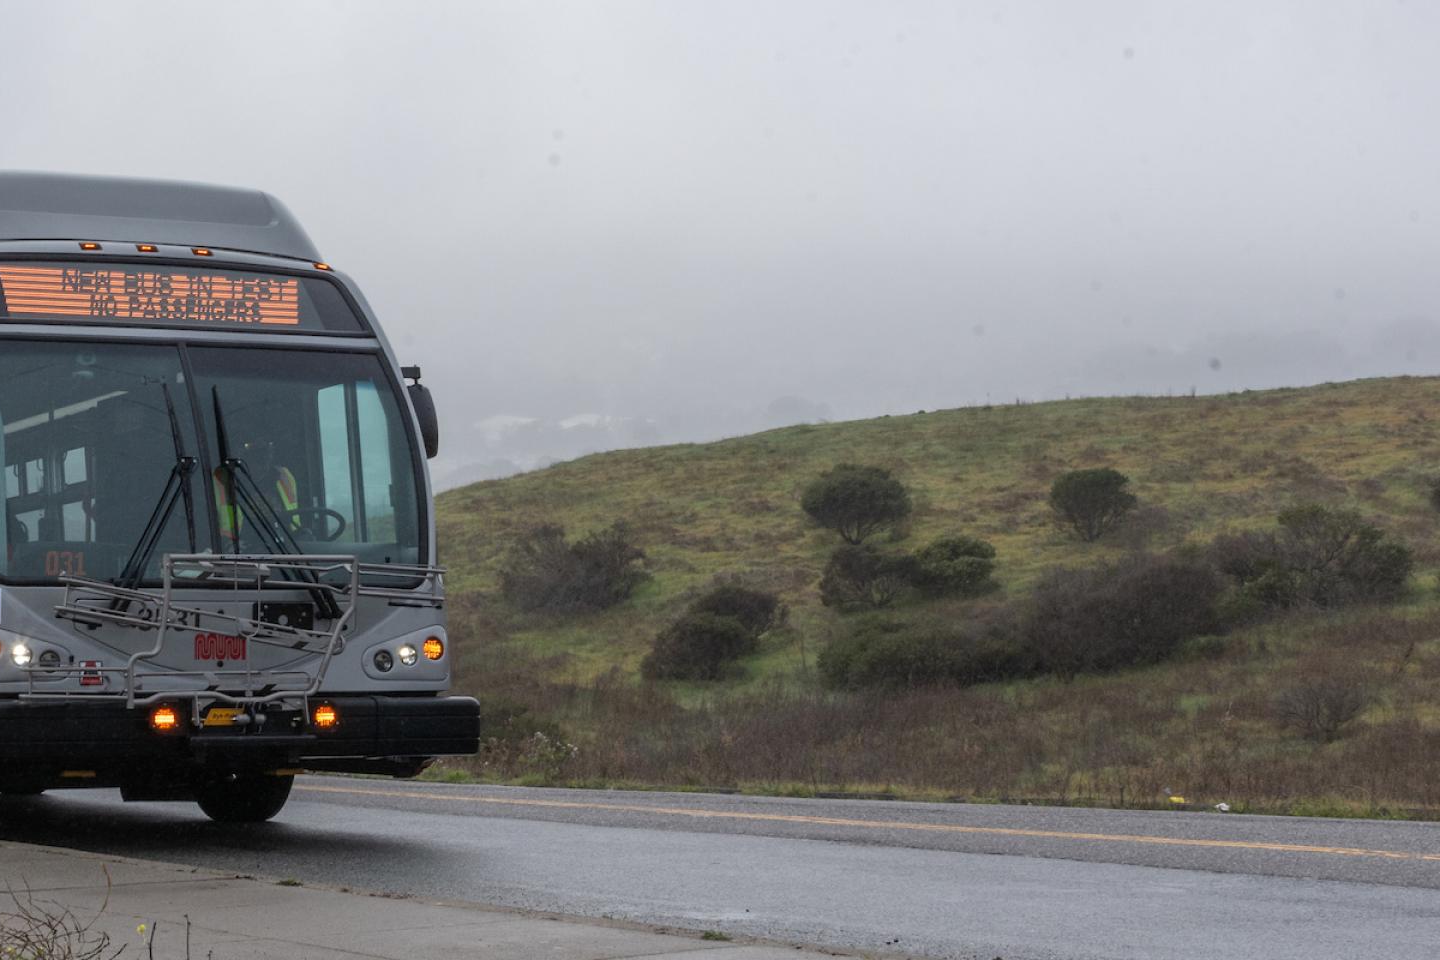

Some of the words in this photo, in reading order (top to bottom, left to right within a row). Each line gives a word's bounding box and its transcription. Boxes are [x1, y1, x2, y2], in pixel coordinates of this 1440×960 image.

[63, 268, 109, 294] NEW
[124, 272, 171, 296] BUS
[90, 293, 116, 316] NO
